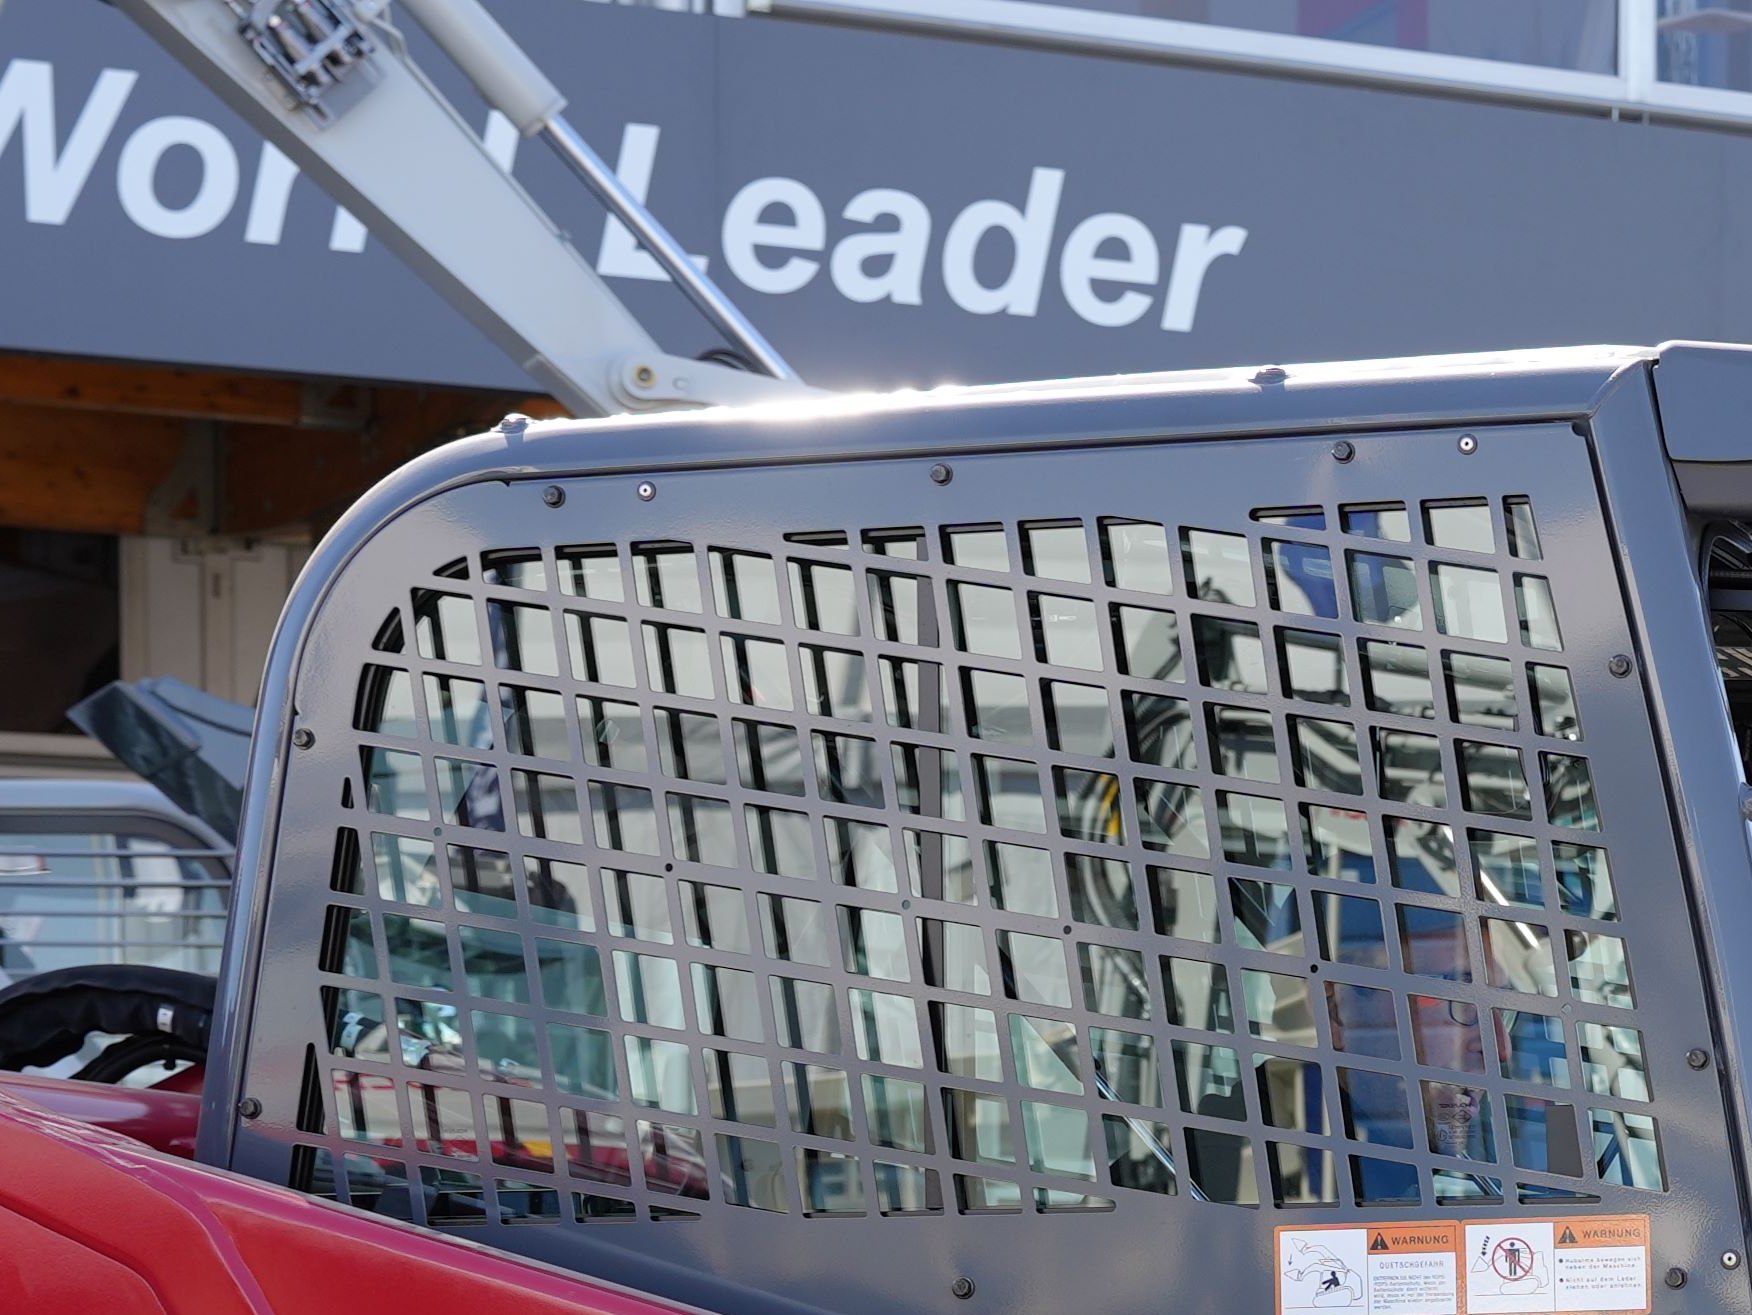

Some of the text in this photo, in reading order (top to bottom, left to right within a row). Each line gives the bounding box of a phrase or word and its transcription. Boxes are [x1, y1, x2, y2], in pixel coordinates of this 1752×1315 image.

[597, 122, 1246, 333] Leader
[1582, 1227, 1641, 1239] WARNUNG
[1391, 1234, 1449, 1246] WARNUNG
